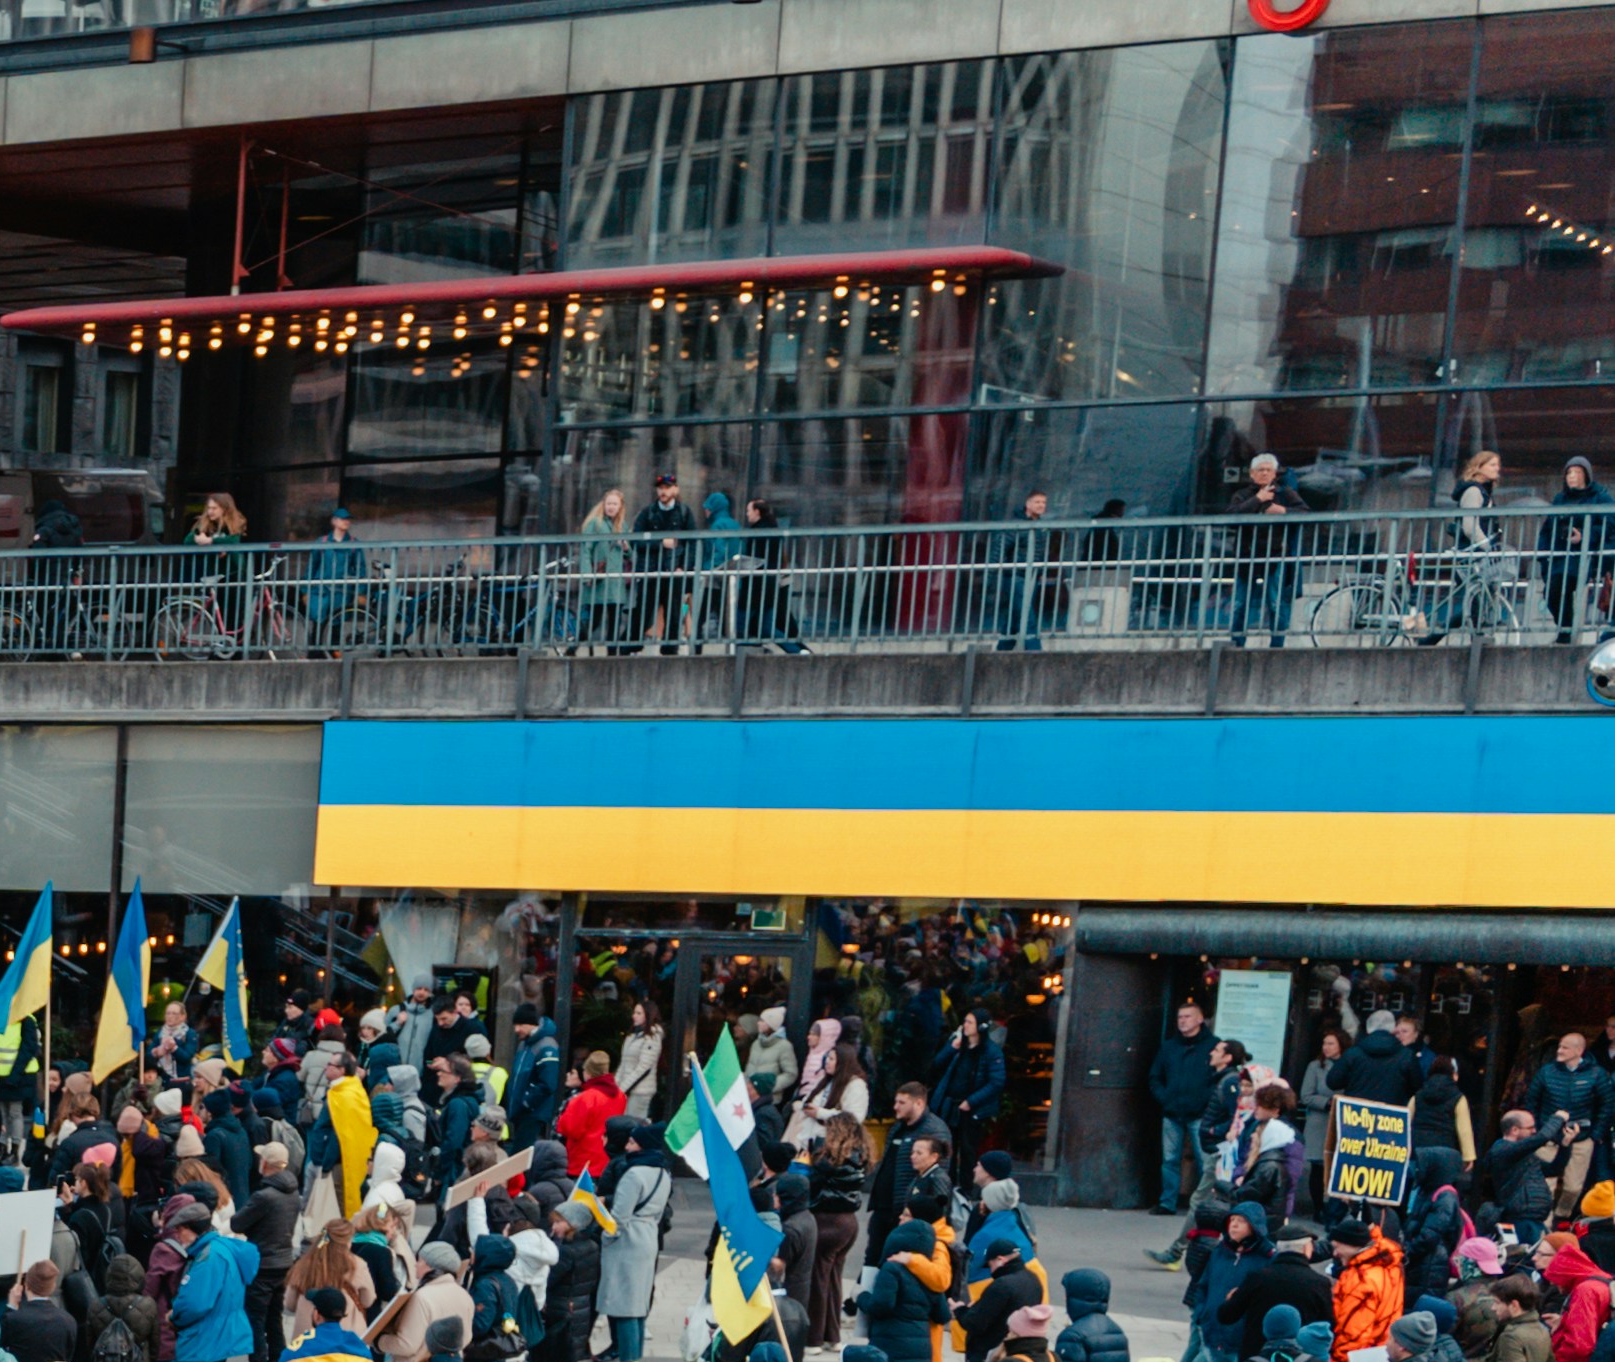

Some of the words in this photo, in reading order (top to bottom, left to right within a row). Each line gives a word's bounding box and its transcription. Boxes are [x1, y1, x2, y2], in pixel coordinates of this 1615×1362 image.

[1342, 1104, 1375, 1134] No-fly
[1376, 1113, 1405, 1134] zone
[1339, 1137, 1365, 1155] over
[1364, 1137, 1408, 1164] Ukraine
[1338, 1164, 1395, 1200] NOW!
